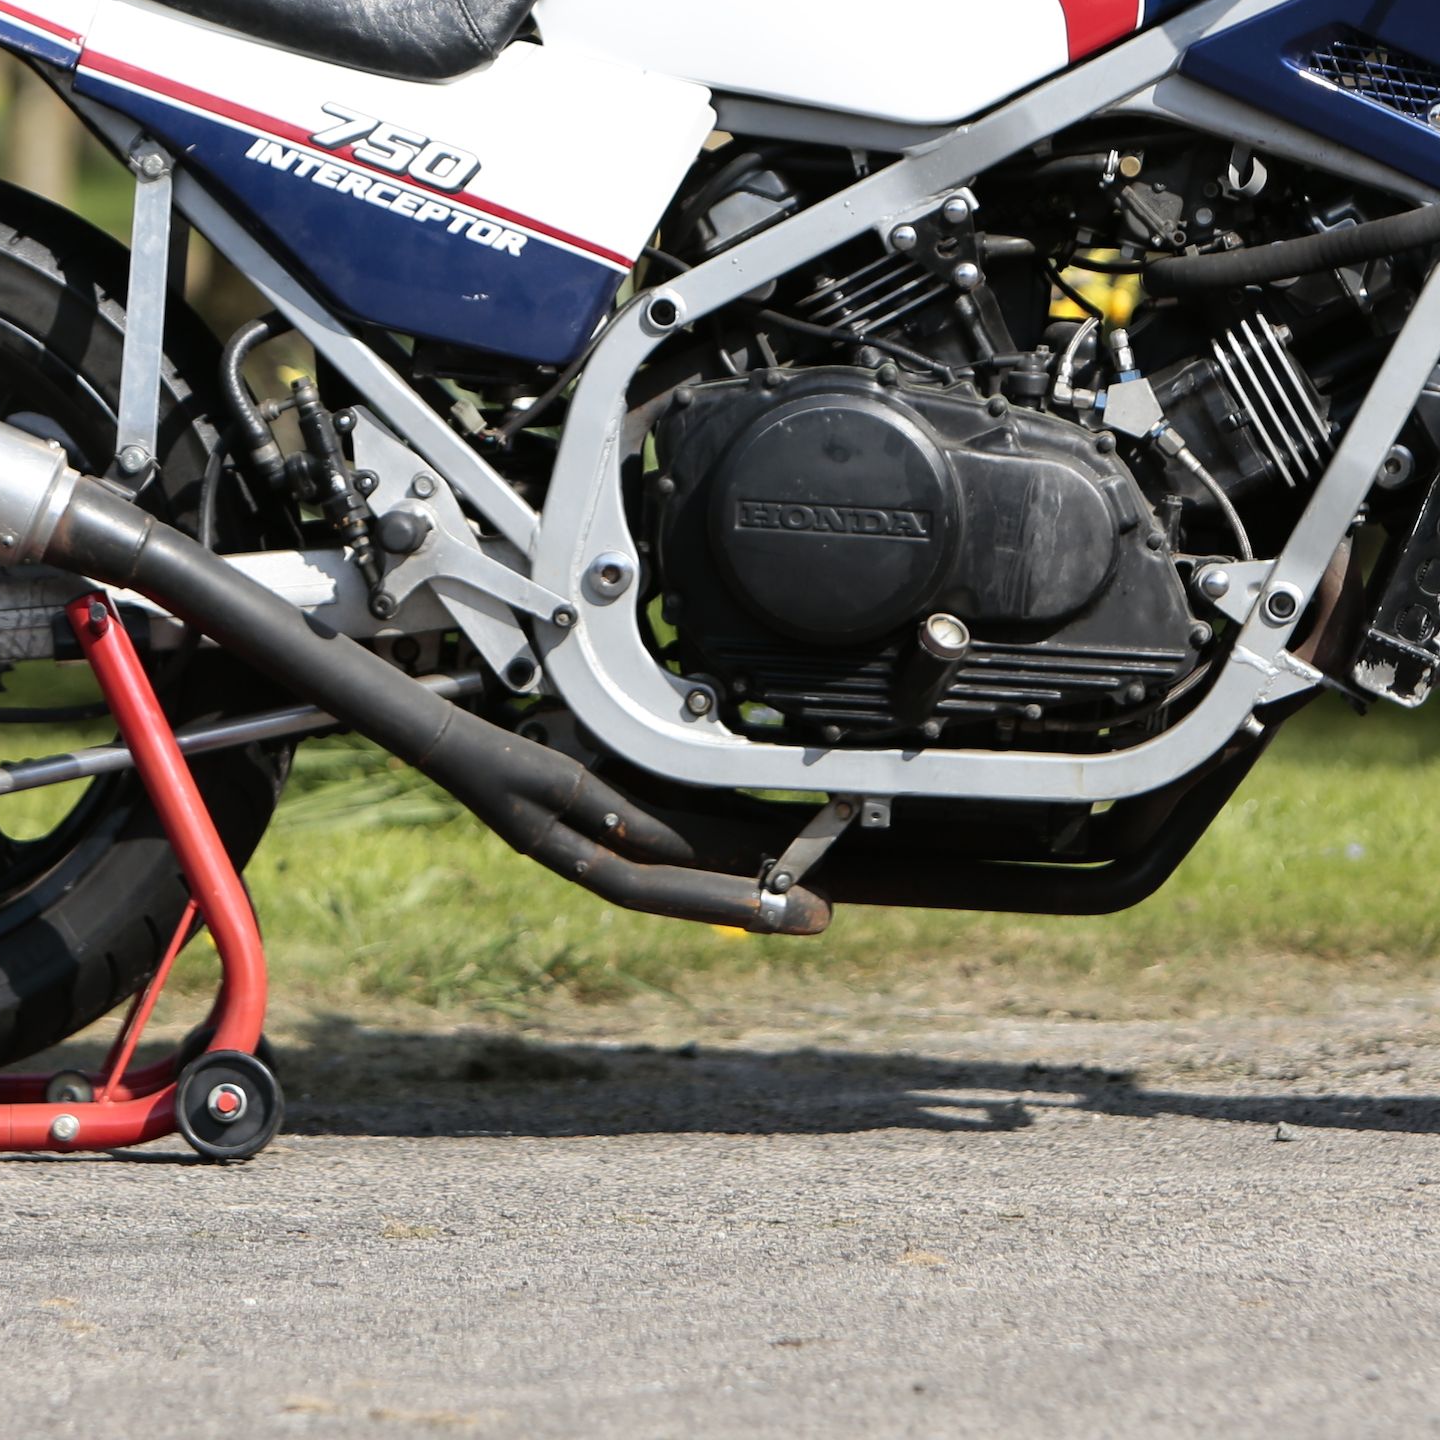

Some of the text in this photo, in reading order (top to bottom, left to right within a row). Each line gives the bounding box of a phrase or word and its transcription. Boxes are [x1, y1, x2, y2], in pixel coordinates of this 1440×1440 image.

[309, 101, 482, 194] 750
[245, 138, 528, 257] INTERCEPTOR
[741, 502, 927, 535] HONDA
